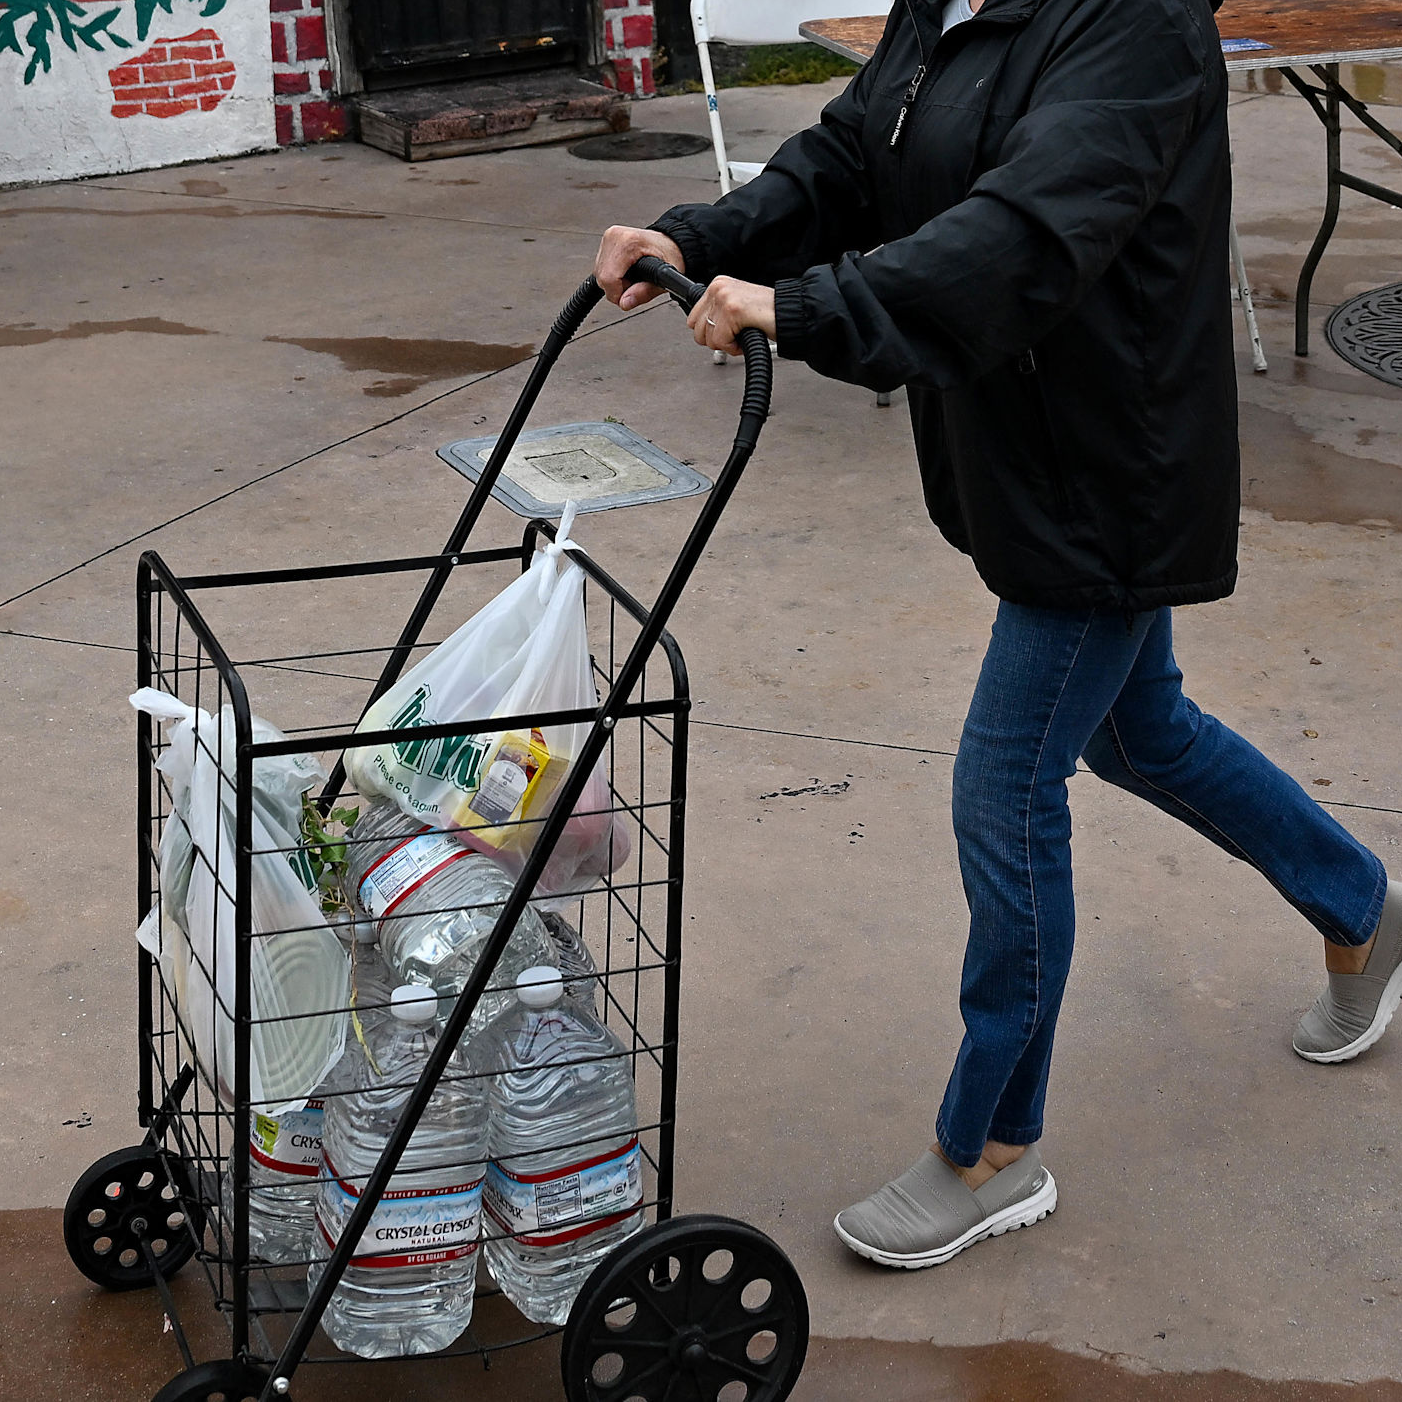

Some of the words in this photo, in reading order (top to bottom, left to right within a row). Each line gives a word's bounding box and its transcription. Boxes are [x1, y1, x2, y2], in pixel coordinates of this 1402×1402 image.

[896, 107, 907, 129] Calvin
[890, 129, 900, 146] Klein
[291, 1134, 322, 1149] CRYS
[375, 1224, 429, 1241] CRYSTAL
[411, 1236, 446, 1245] NATURAL
